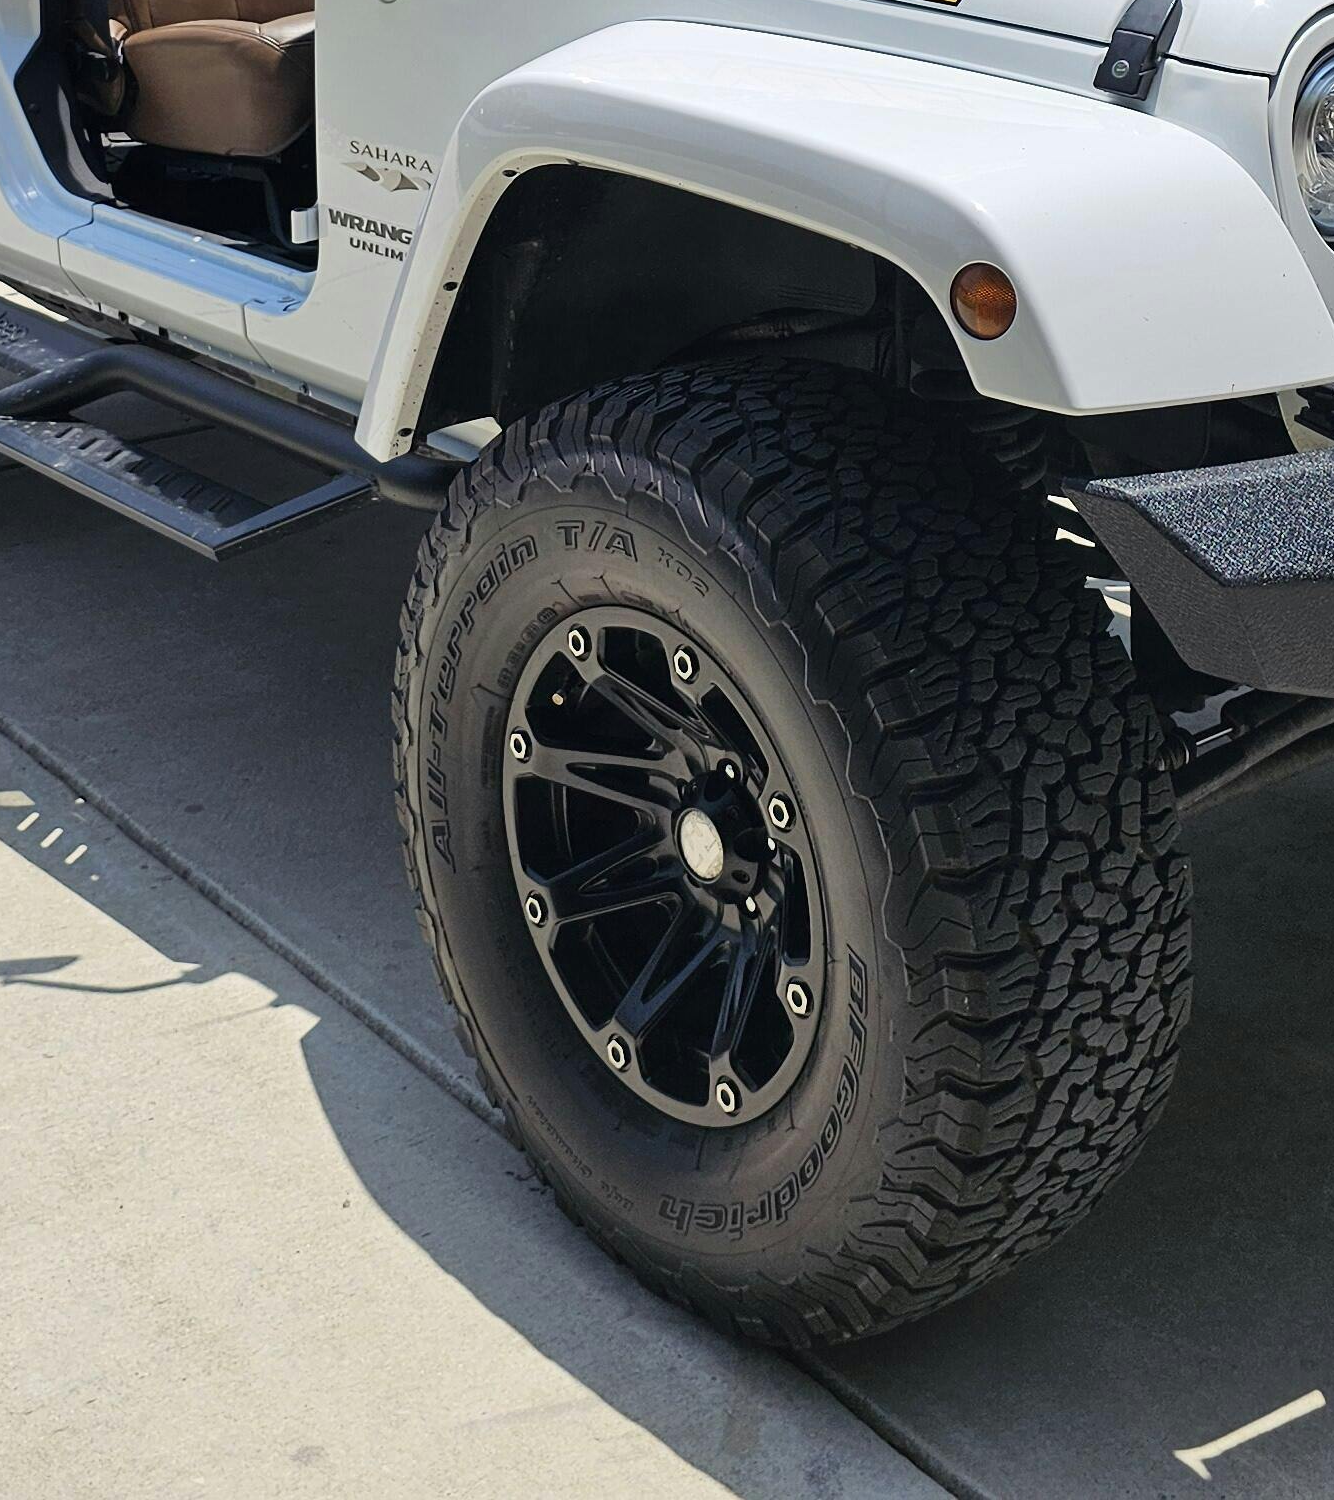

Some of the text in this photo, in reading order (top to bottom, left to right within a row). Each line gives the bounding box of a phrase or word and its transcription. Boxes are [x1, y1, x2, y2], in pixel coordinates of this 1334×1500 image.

[349, 140, 434, 174] SAHARA
[328, 208, 413, 245] WRANG
[349, 237, 407, 261] UNLIM
[427, 535, 538, 874] All-Terrain
[555, 519, 639, 563] T/A
[659, 949, 867, 1241] BFGoodrich
